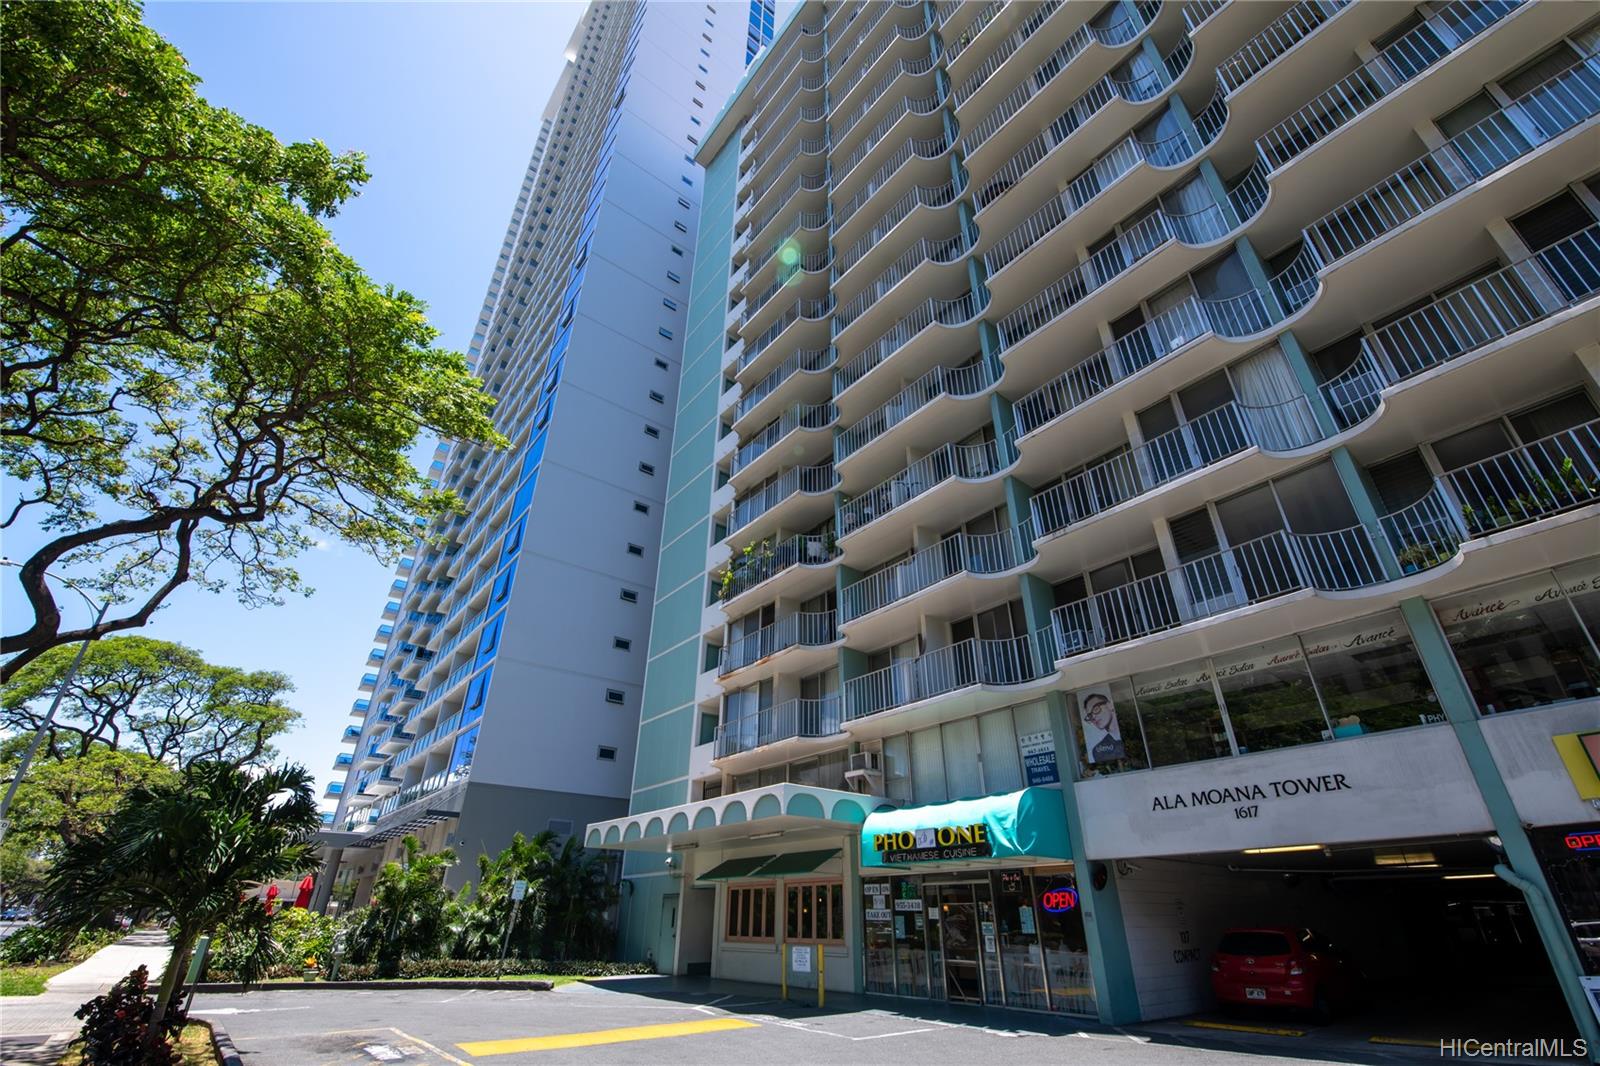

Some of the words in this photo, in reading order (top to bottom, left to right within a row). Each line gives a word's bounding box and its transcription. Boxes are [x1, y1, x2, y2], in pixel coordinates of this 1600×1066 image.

[1229, 662, 1254, 676] Salon
[1025, 753, 1056, 767] WHOLESALE
[1031, 765, 1051, 774] TRAVEL
[1152, 794, 1187, 811] ALA
[1191, 784, 1267, 807] MOANA
[1269, 774, 1352, 797] TOWER
[1234, 805, 1259, 820] 1617
[873, 831, 915, 852] PHO
[937, 823, 986, 847] ONE
[889, 850, 939, 862] VIETNAMESE
[943, 847, 977, 859] CUISINE
[1043, 891, 1075, 908] OPEN
